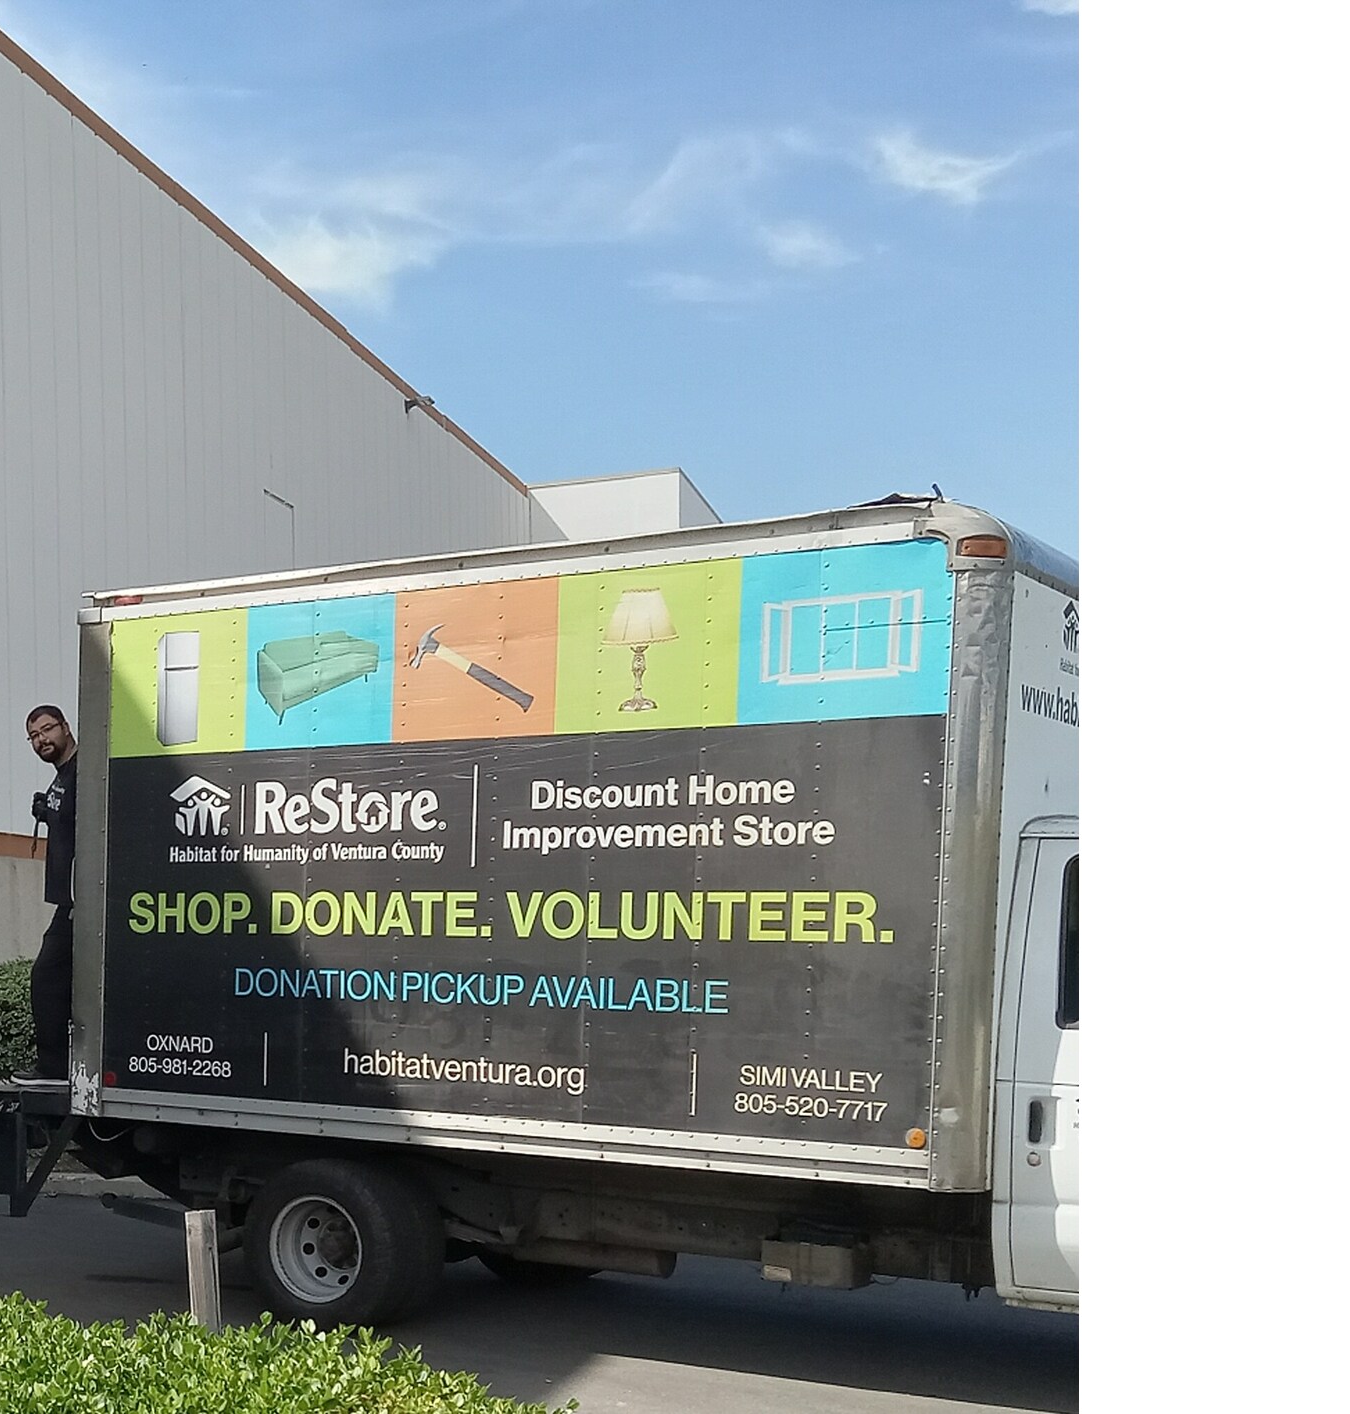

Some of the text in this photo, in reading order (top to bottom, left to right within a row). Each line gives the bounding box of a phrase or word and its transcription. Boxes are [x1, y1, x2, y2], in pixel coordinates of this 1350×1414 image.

[1021, 684, 1079, 727] www.hab
[254, 777, 439, 835] ReStore
[531, 774, 796, 810] Discount Home
[169, 842, 445, 865] Habitat for Humanity of Ventura County
[502, 814, 836, 855] Improvement Store
[128, 891, 895, 943] SHOP. DONATE. VOLUNTEER.
[234, 967, 730, 1014] DONATION PICKUP AVAILABLE
[146, 1034, 214, 1054] OXNARD
[128, 1056, 232, 1079] 805-981-2268
[343, 1047, 587, 1096] habitatventura.org
[739, 1064, 883, 1093] SIMI VALLEY
[733, 1092, 888, 1122] 805-520-7717
